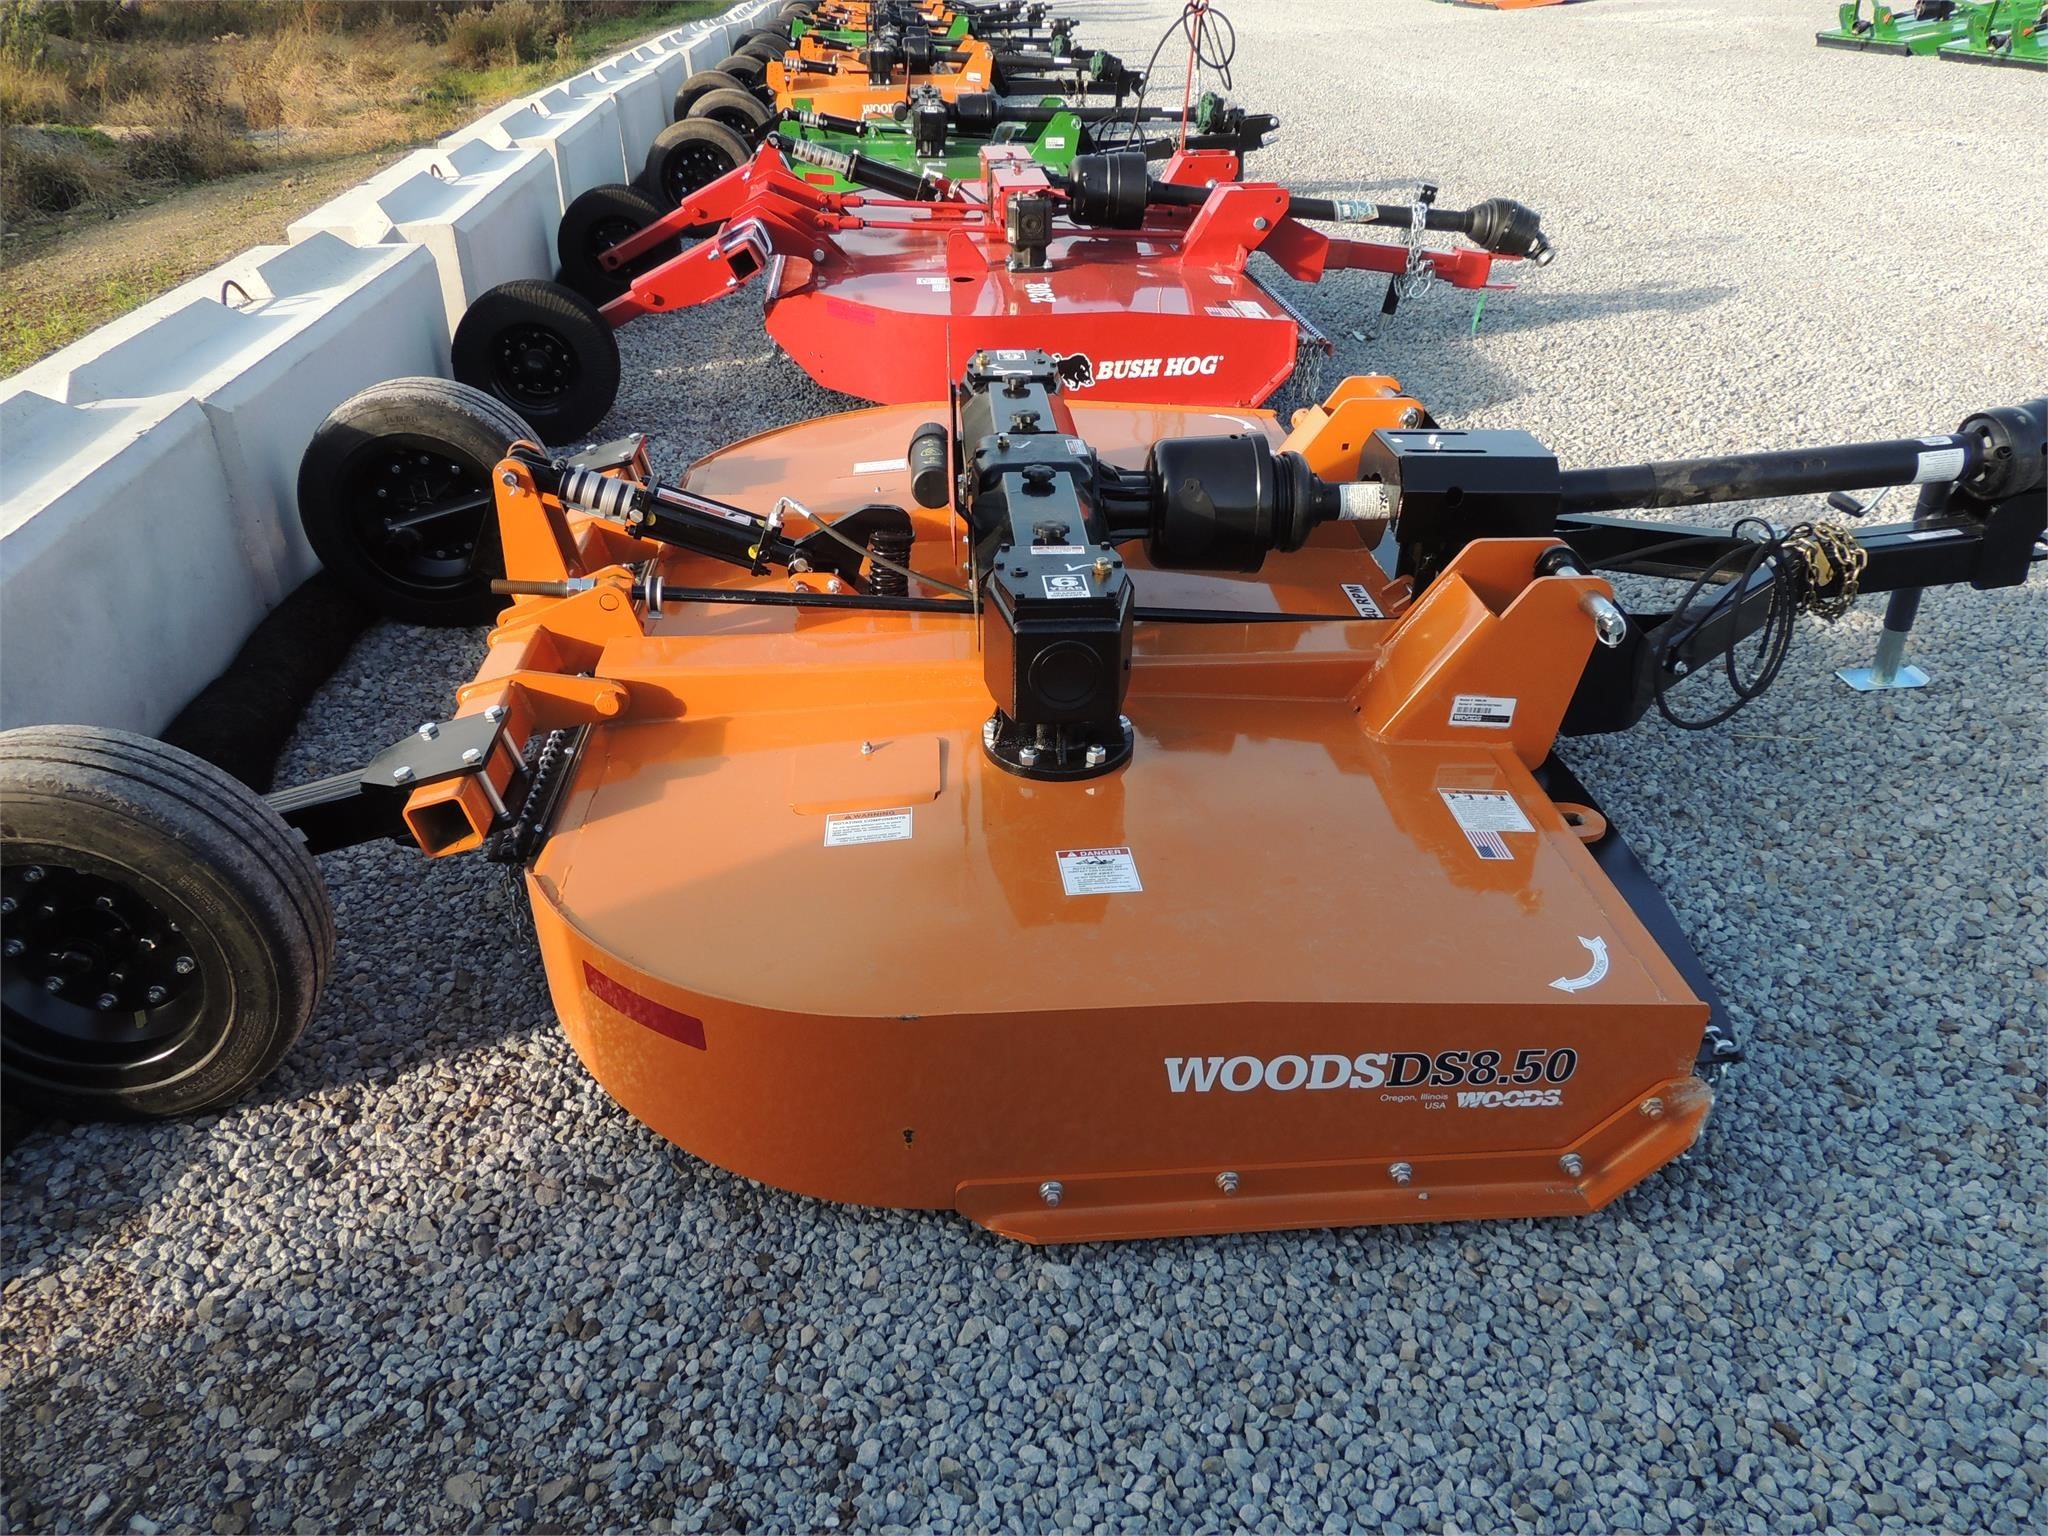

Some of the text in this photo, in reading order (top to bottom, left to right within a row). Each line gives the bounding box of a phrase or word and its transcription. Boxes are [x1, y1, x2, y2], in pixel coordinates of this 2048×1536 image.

[1025, 283, 1057, 303] 2308
[1095, 355, 1218, 380] BUSH HOG
[1051, 576, 1079, 587] 6
[1346, 585, 1372, 605] RPM
[853, 810, 896, 820] WARNING
[1080, 849, 1121, 857] DANGER
[1380, 1092, 1449, 1103] Oregon, Illinois
[1457, 1089, 1562, 1108] WOODS
[1424, 1102, 1446, 1110] USA
